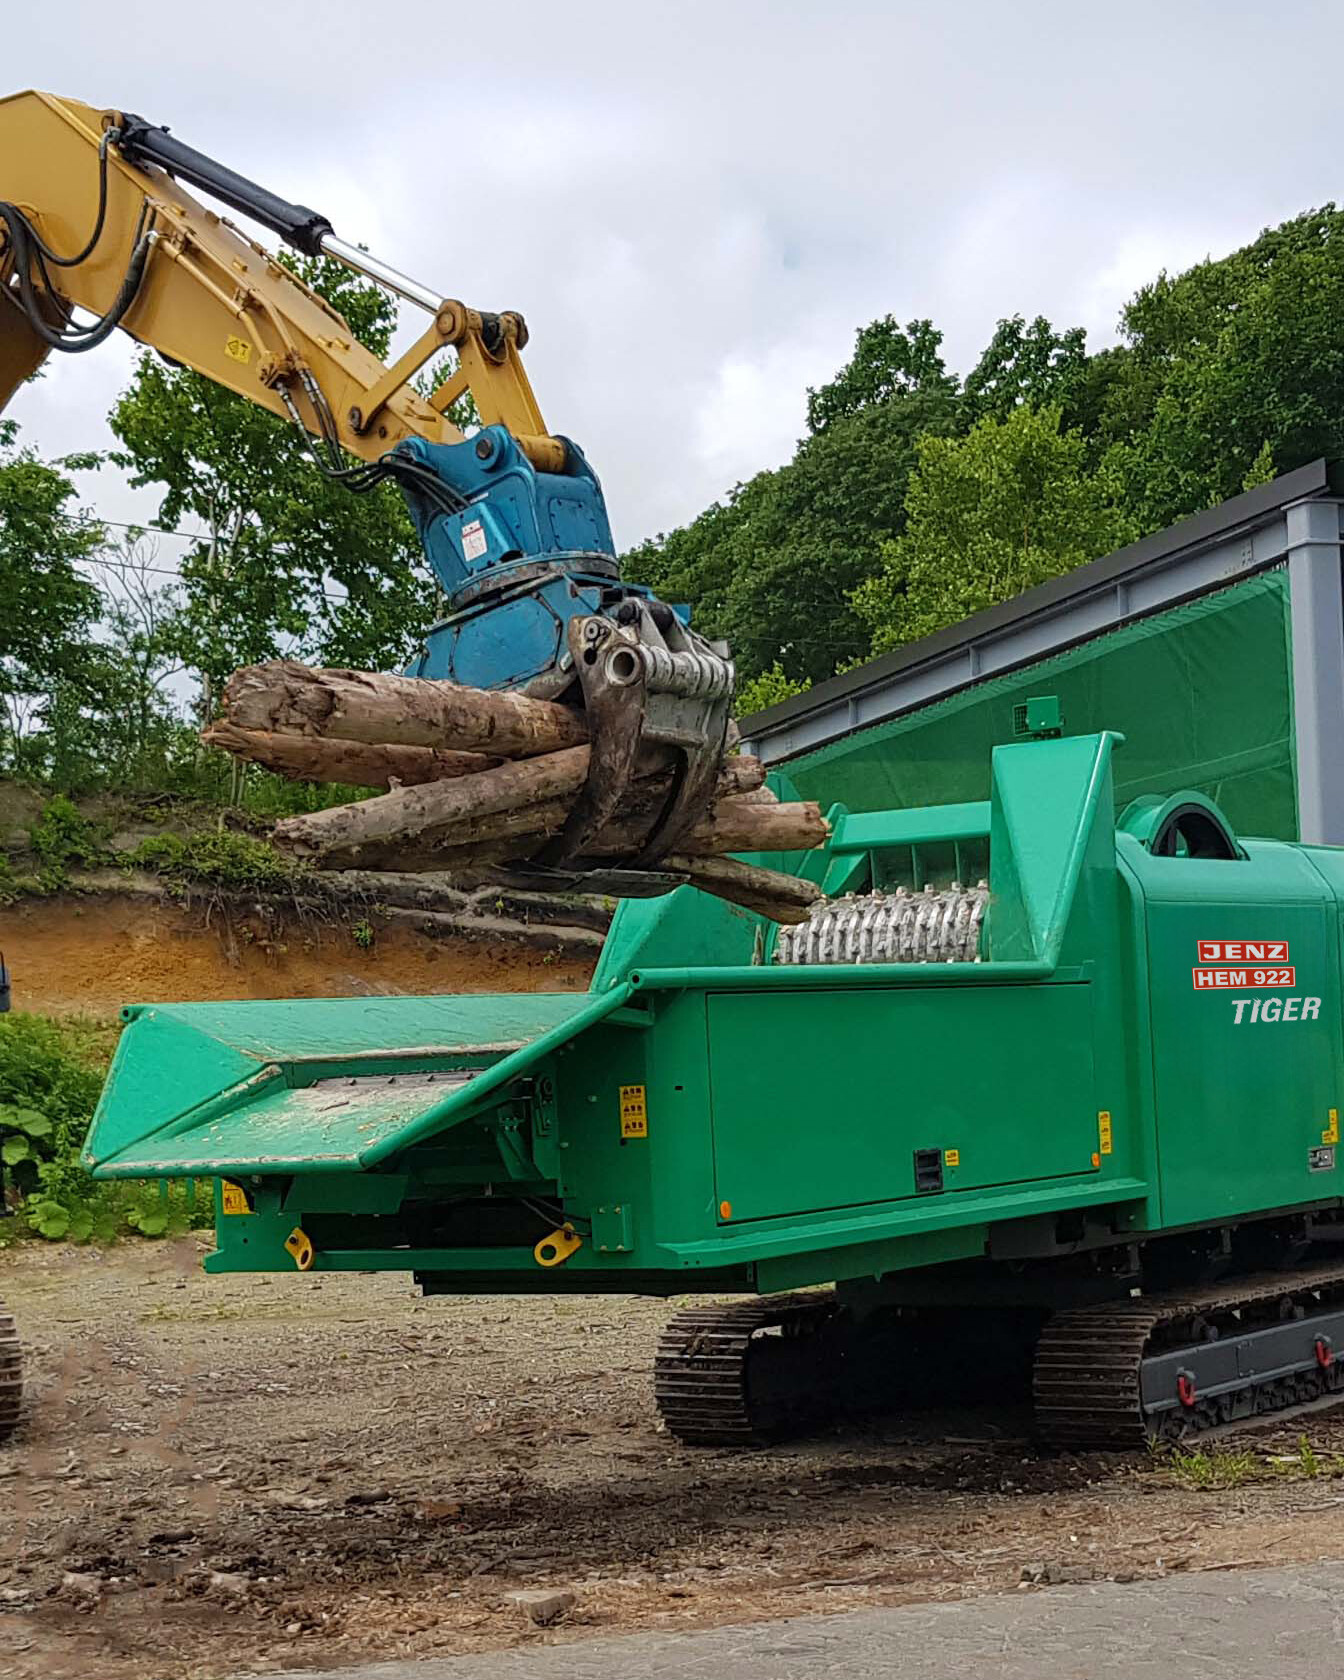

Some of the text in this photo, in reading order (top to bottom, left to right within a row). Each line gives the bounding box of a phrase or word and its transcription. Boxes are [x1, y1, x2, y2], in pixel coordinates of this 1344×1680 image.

[1203, 944, 1284, 959] JENZ
[1197, 970, 1291, 986] HEM 922
[1231, 996, 1322, 1024] TIGER
